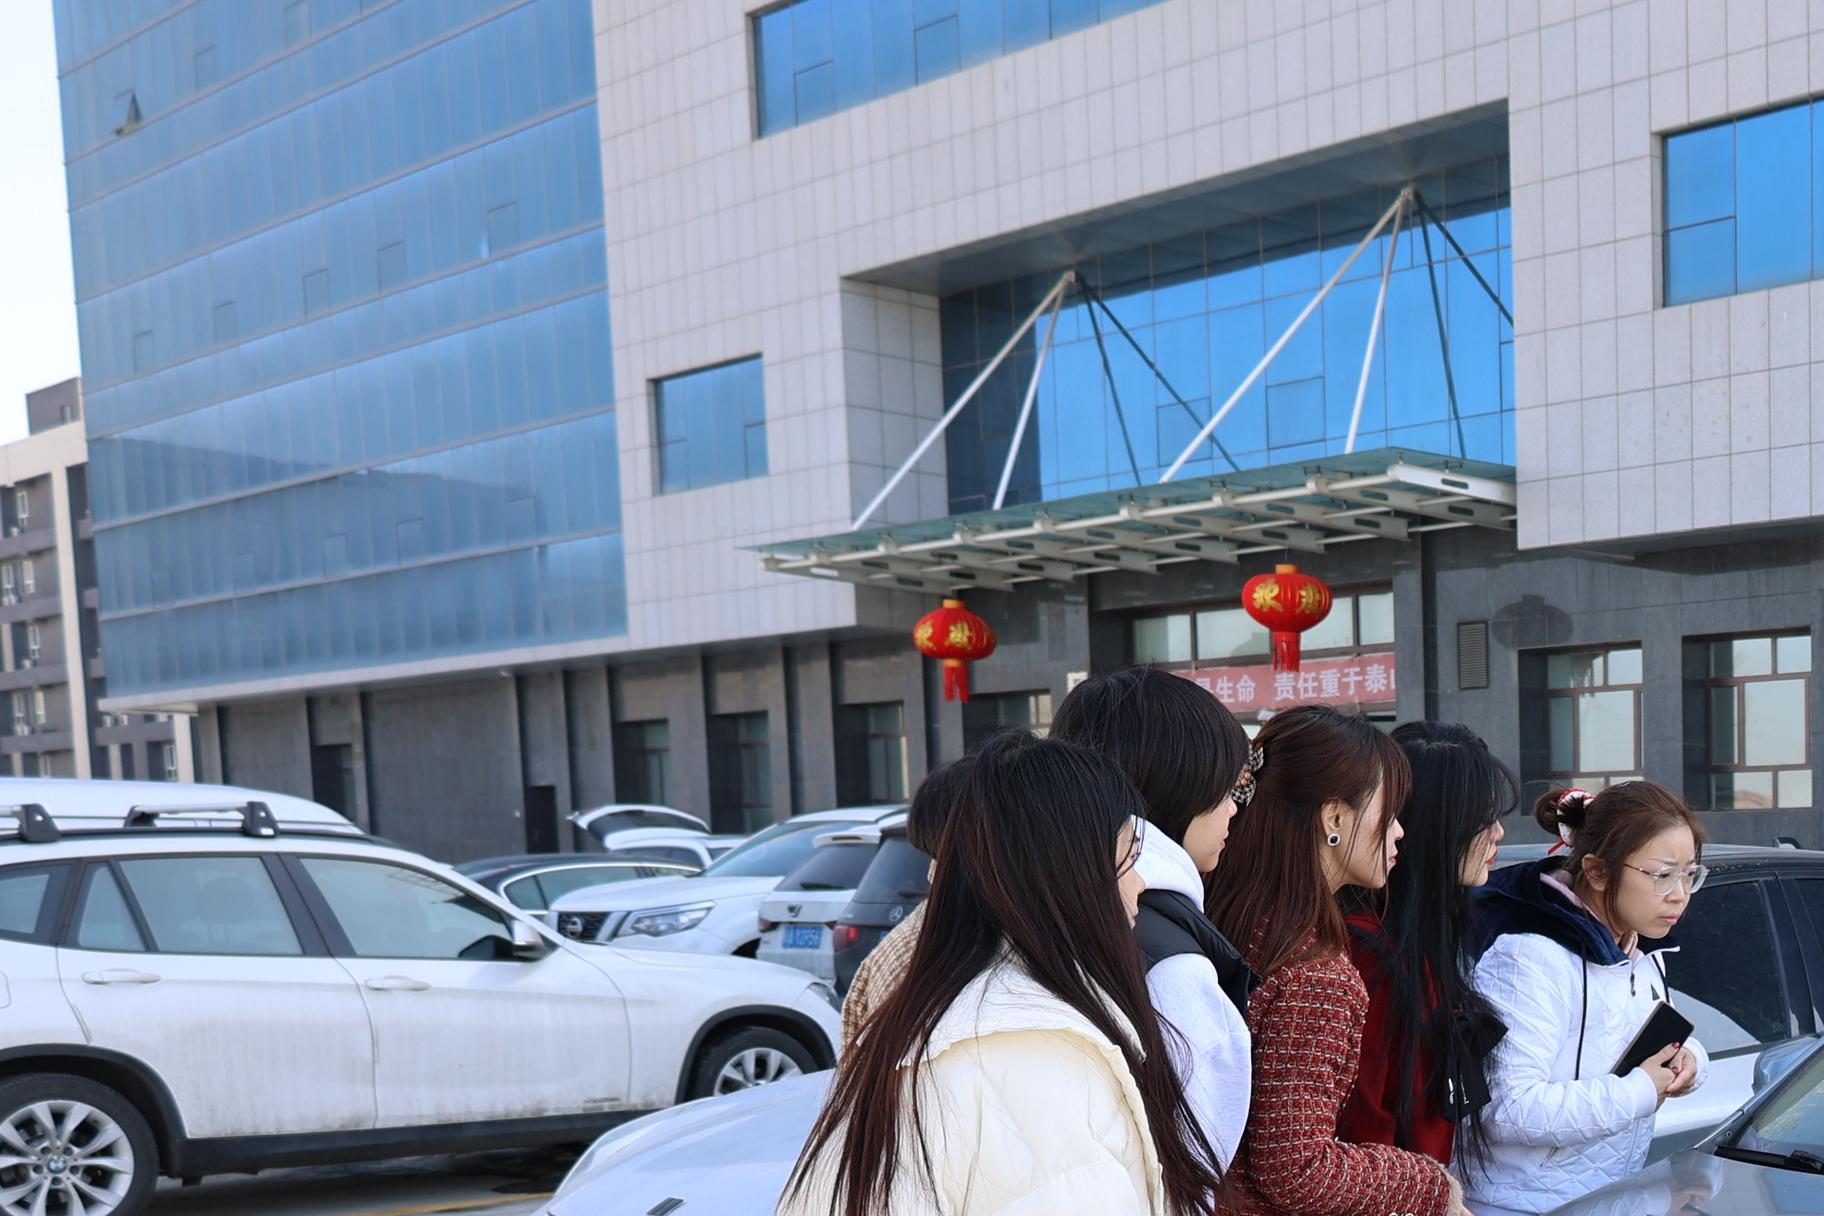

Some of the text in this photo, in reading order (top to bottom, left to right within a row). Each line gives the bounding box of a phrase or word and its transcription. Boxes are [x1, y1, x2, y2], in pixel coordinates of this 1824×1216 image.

[1274, 663, 1396, 701] 责任重于泰
